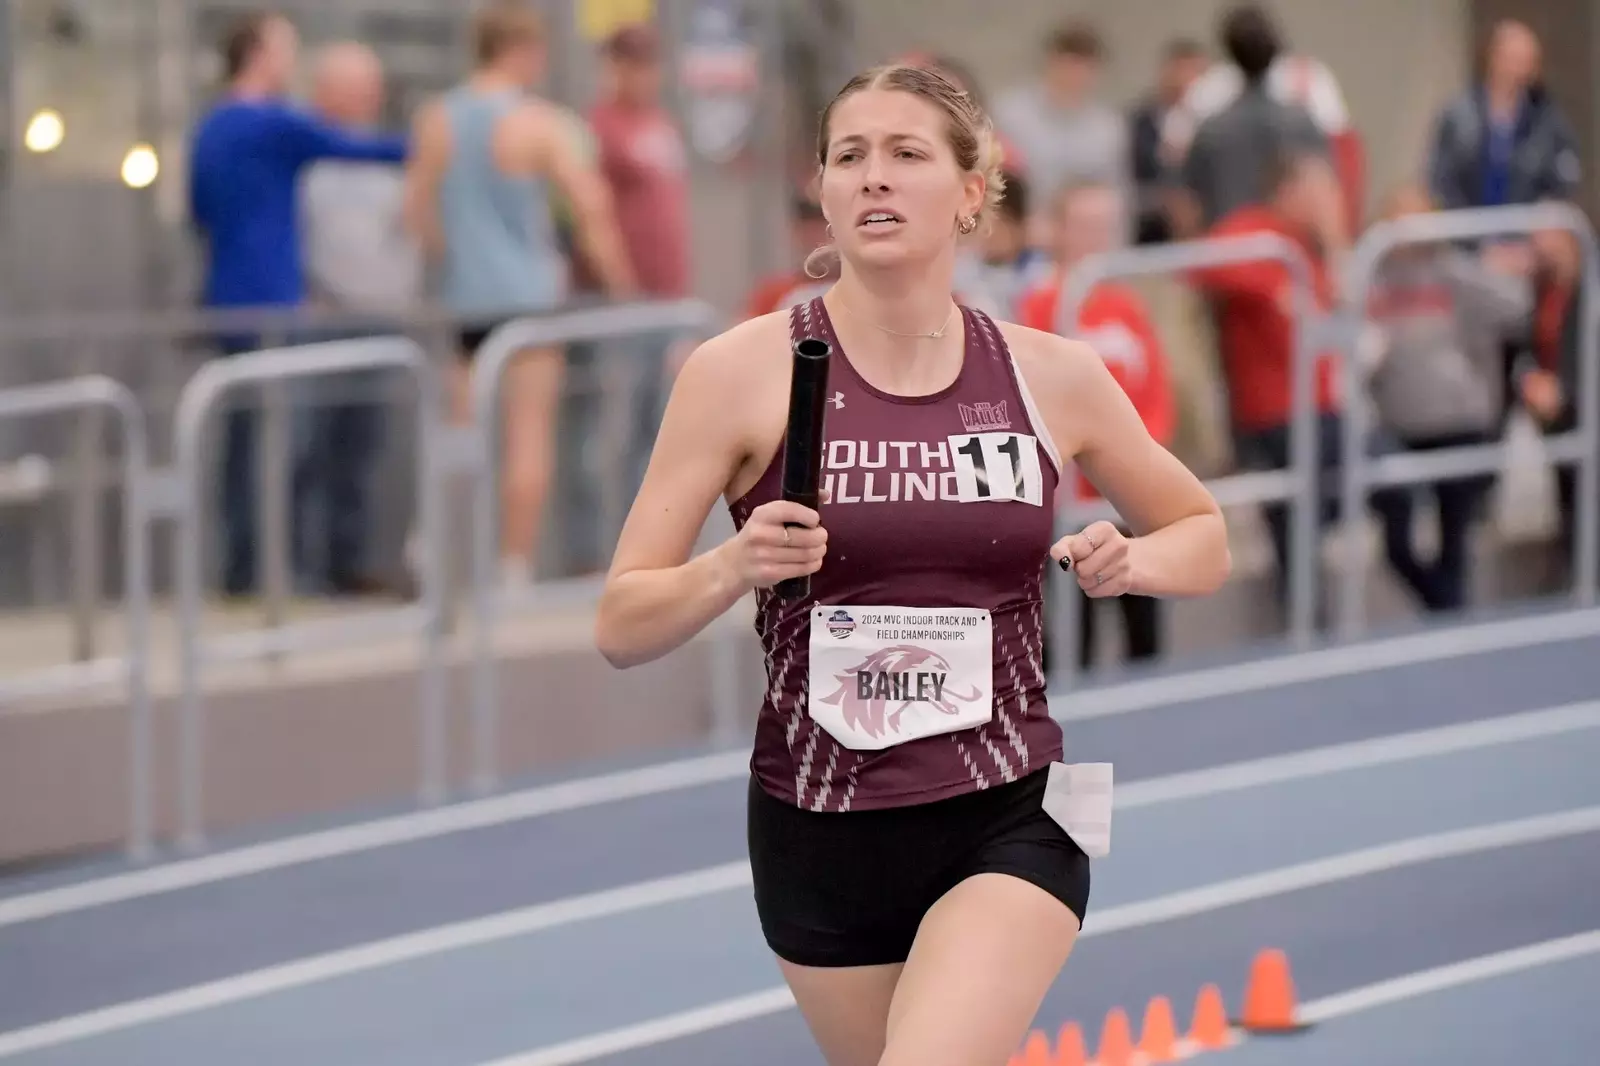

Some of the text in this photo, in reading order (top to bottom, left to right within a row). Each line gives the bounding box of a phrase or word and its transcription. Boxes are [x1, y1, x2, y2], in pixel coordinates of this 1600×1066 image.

[958, 400, 1009, 427] VALLEY
[820, 440, 949, 469] OUTH
[957, 436, 1026, 499] 11
[861, 614, 882, 625] 2024
[883, 614, 901, 625] MVC
[903, 615, 933, 626] INDOOR
[935, 615, 960, 626] TRACK
[960, 616, 977, 627] AND
[877, 629, 965, 641] FIELD CHAMPIONSHIPS
[857, 670, 947, 702] BAILEY
